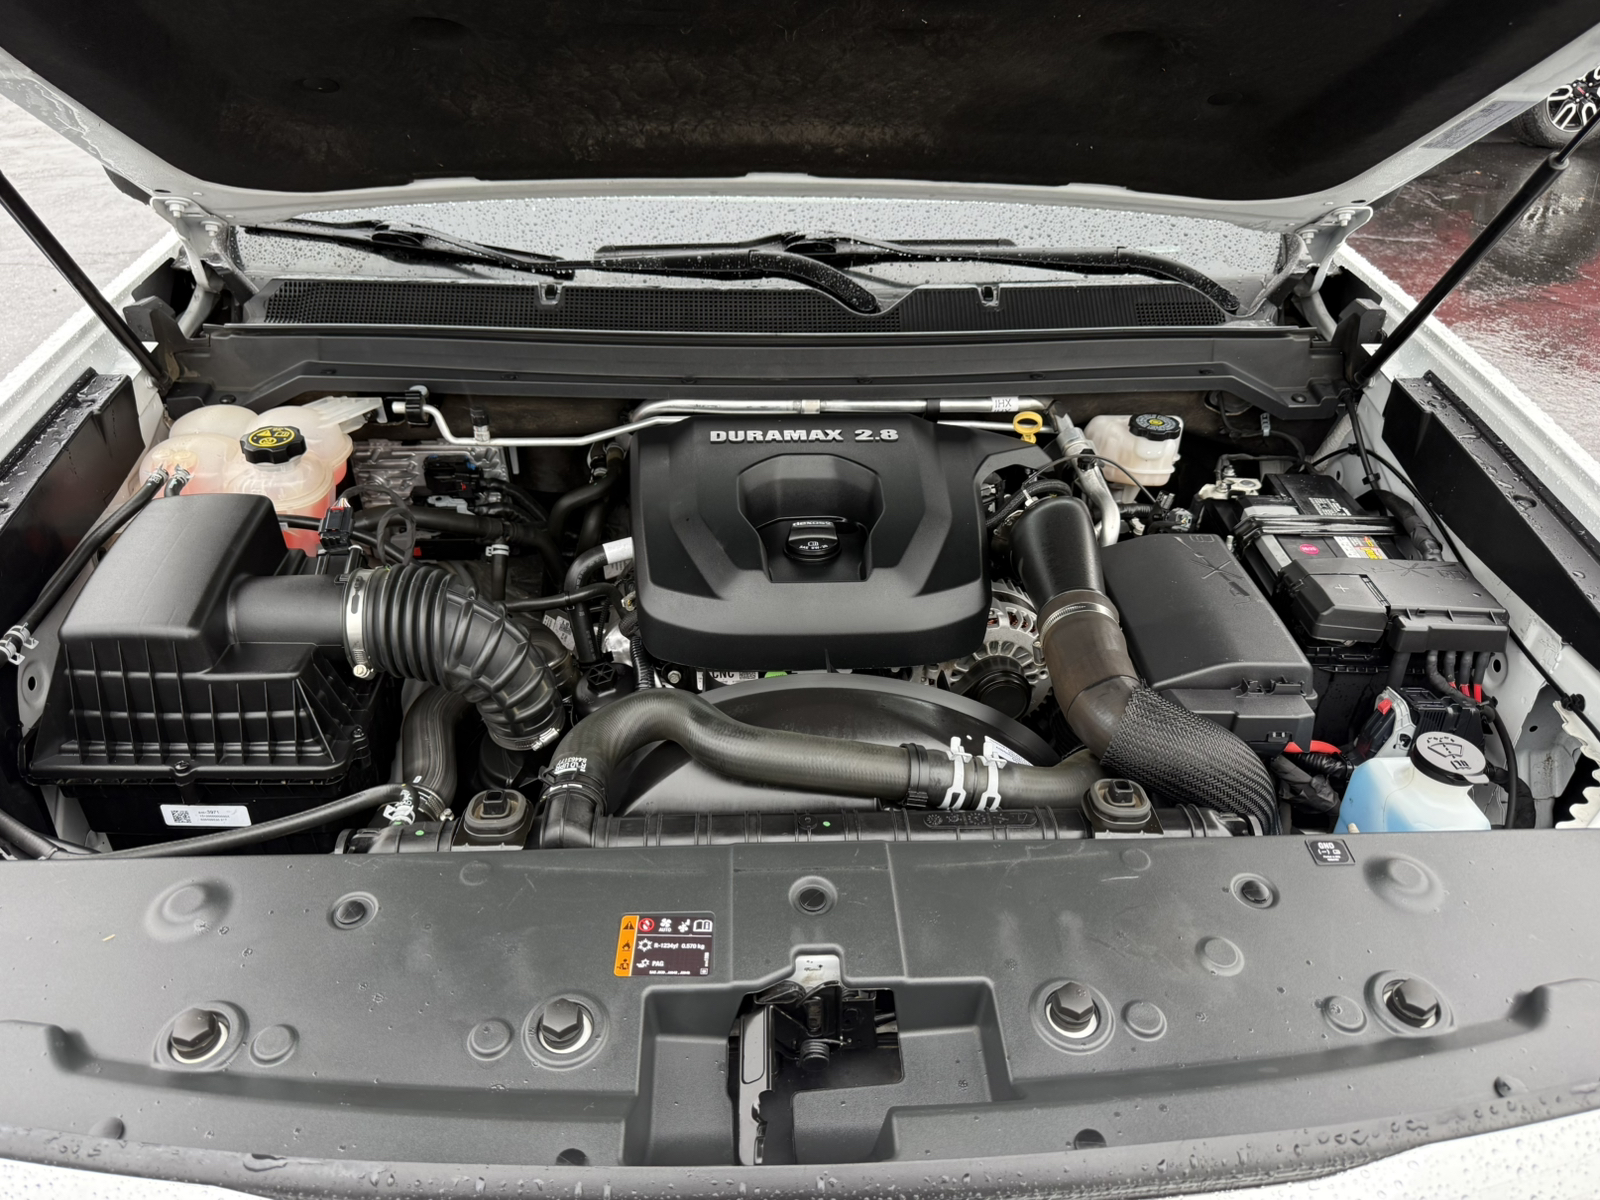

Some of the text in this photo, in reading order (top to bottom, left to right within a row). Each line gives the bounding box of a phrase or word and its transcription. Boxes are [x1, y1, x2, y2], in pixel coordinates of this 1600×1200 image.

[709, 428, 899, 443] DURAMAX 2.8
[1317, 841, 1335, 850] GND
